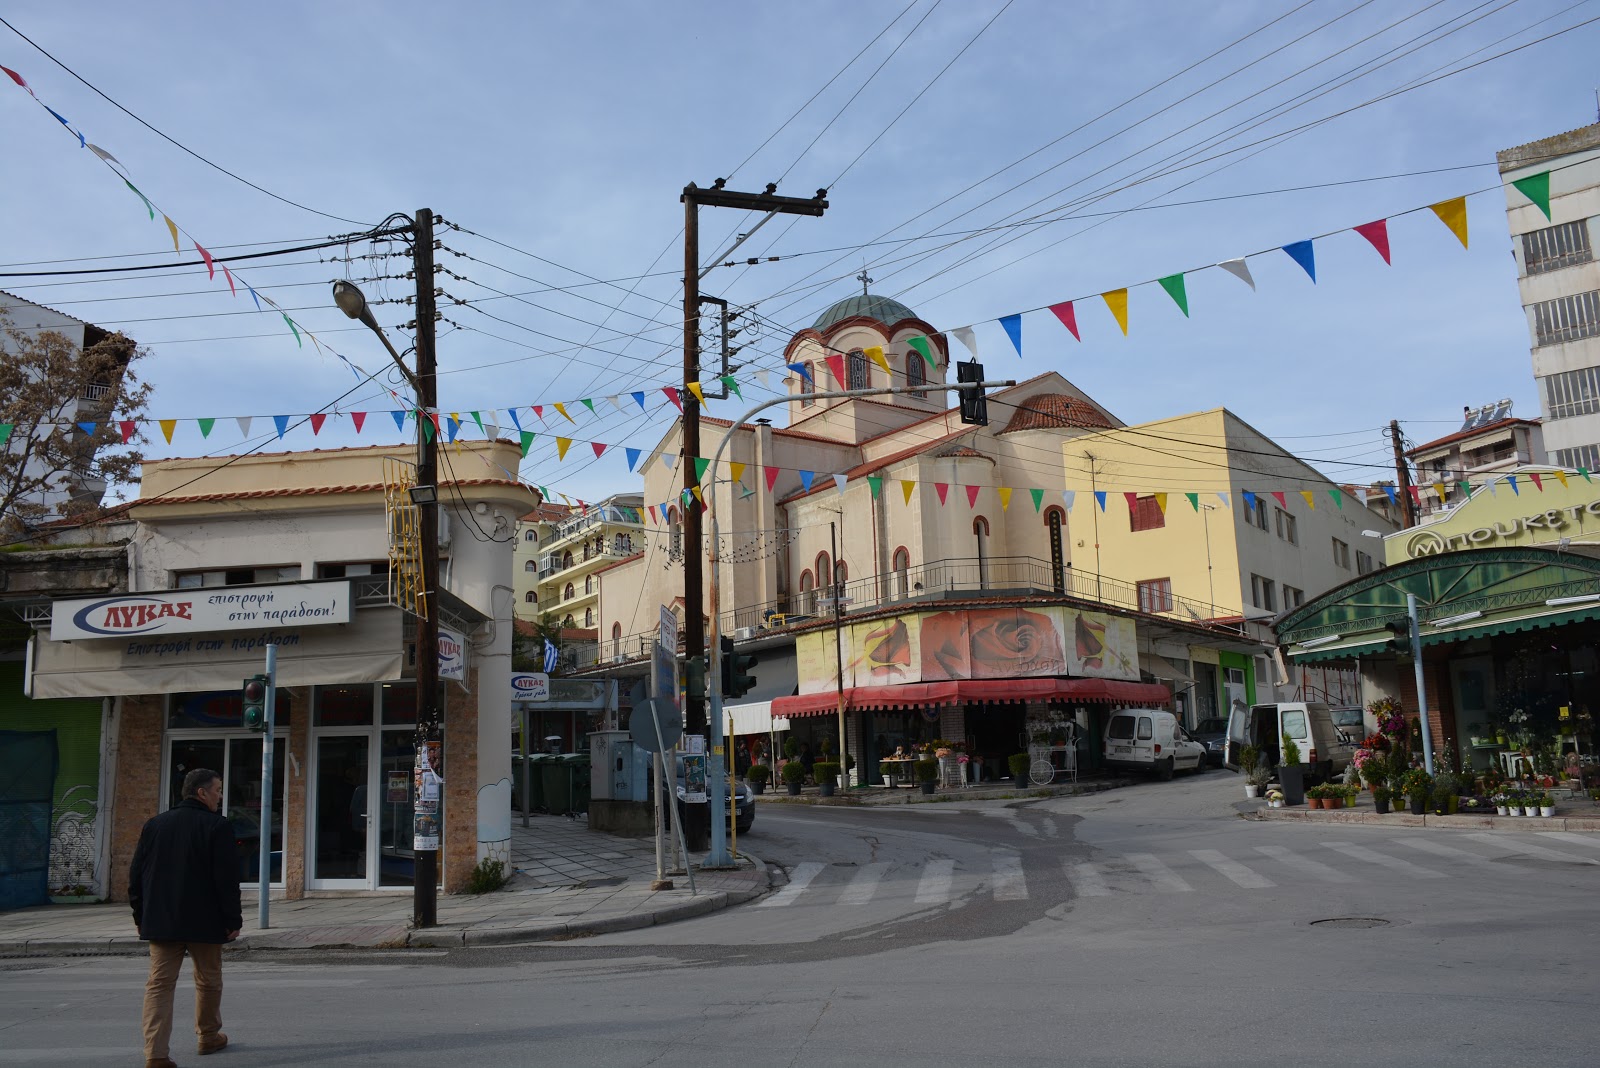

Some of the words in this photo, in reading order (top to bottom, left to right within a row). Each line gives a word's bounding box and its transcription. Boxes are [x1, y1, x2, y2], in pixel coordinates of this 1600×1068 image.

[207, 590, 275, 608] επιστροφή
[103, 601, 193, 628] ΛΥΚΑΣ
[228, 609, 259, 622] στην
[262, 599, 337, 625] παράδοση!
[127, 638, 193, 656] Επιστροφή
[196, 637, 225, 652] στην
[518, 679, 544, 687] ΛΥΚΑΣ
